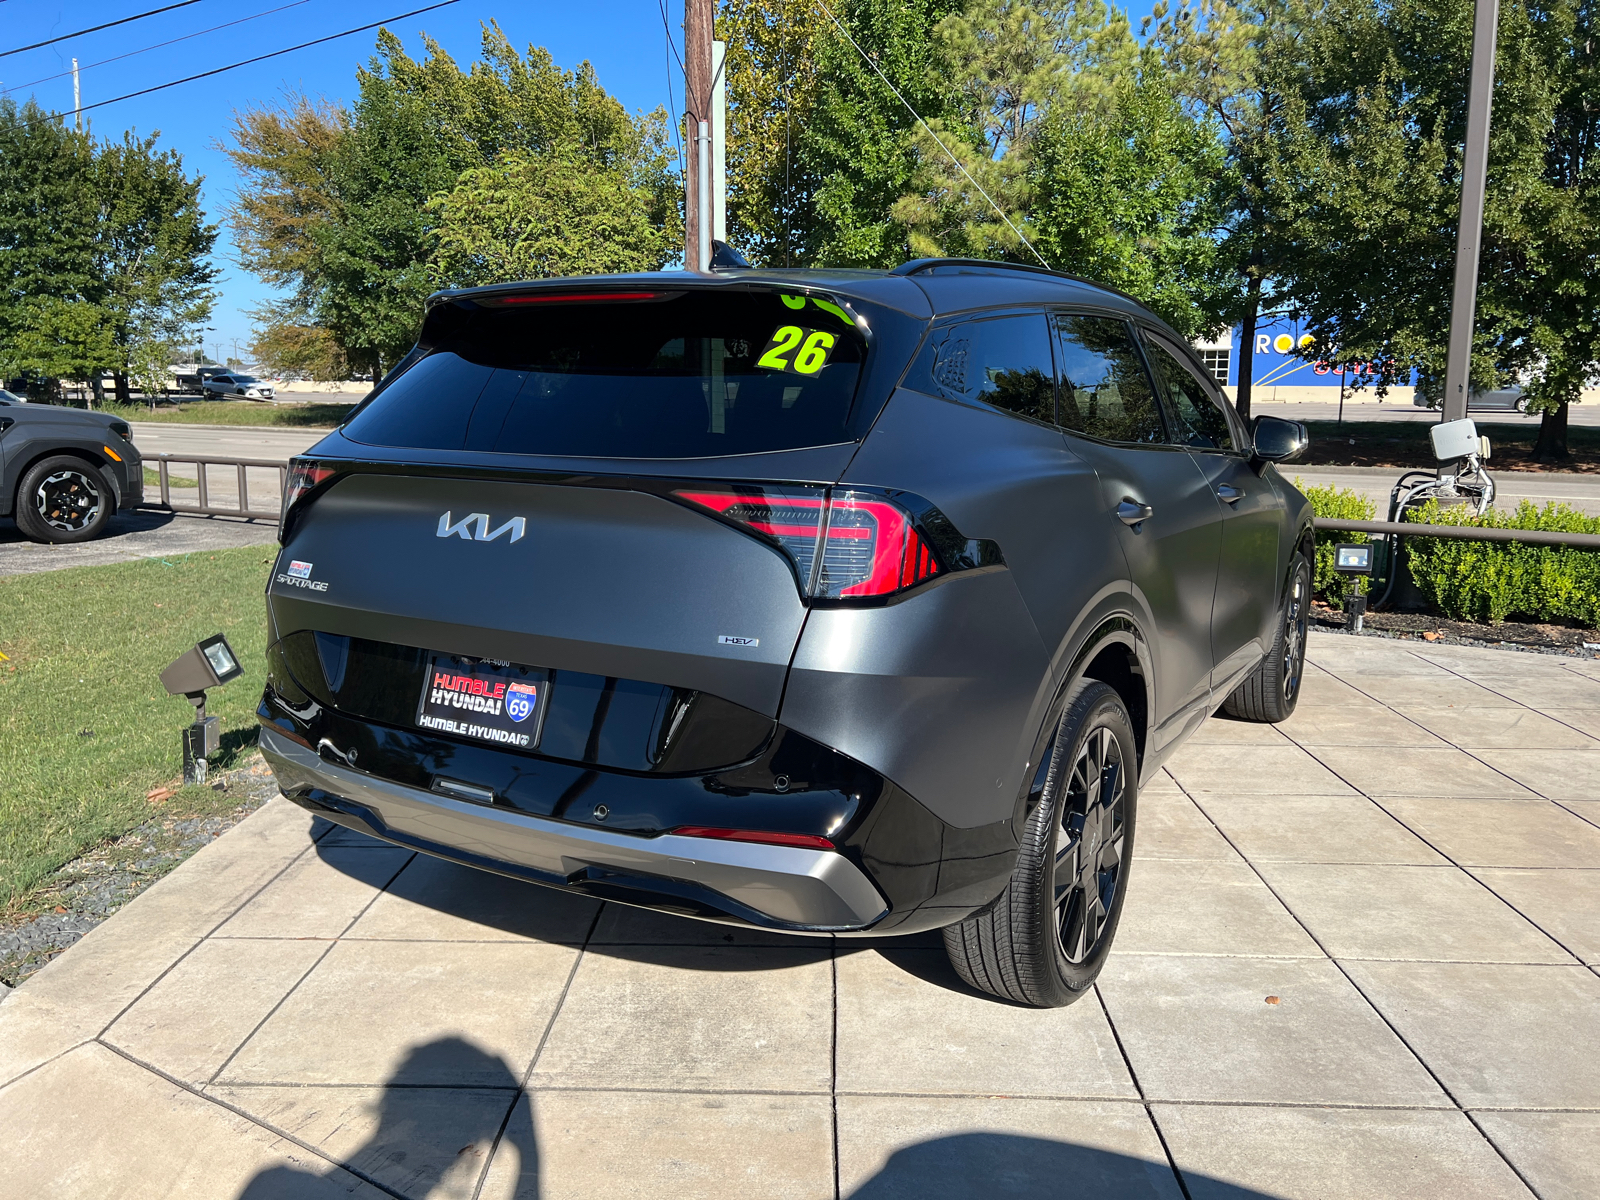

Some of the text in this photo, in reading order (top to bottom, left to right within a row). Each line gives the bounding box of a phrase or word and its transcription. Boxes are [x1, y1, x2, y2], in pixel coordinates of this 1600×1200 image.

[757, 325, 835, 374] 26
[436, 510, 527, 544] KIA
[276, 573, 329, 592] SPORTAGE
[725, 637, 753, 645] HEV
[433, 672, 506, 699] HUMBLE
[430, 688, 502, 716] HYUNDAI
[509, 699, 529, 717] 69
[419, 715, 468, 735] HUMBLE
[468, 725, 520, 745] HYUNDAI
